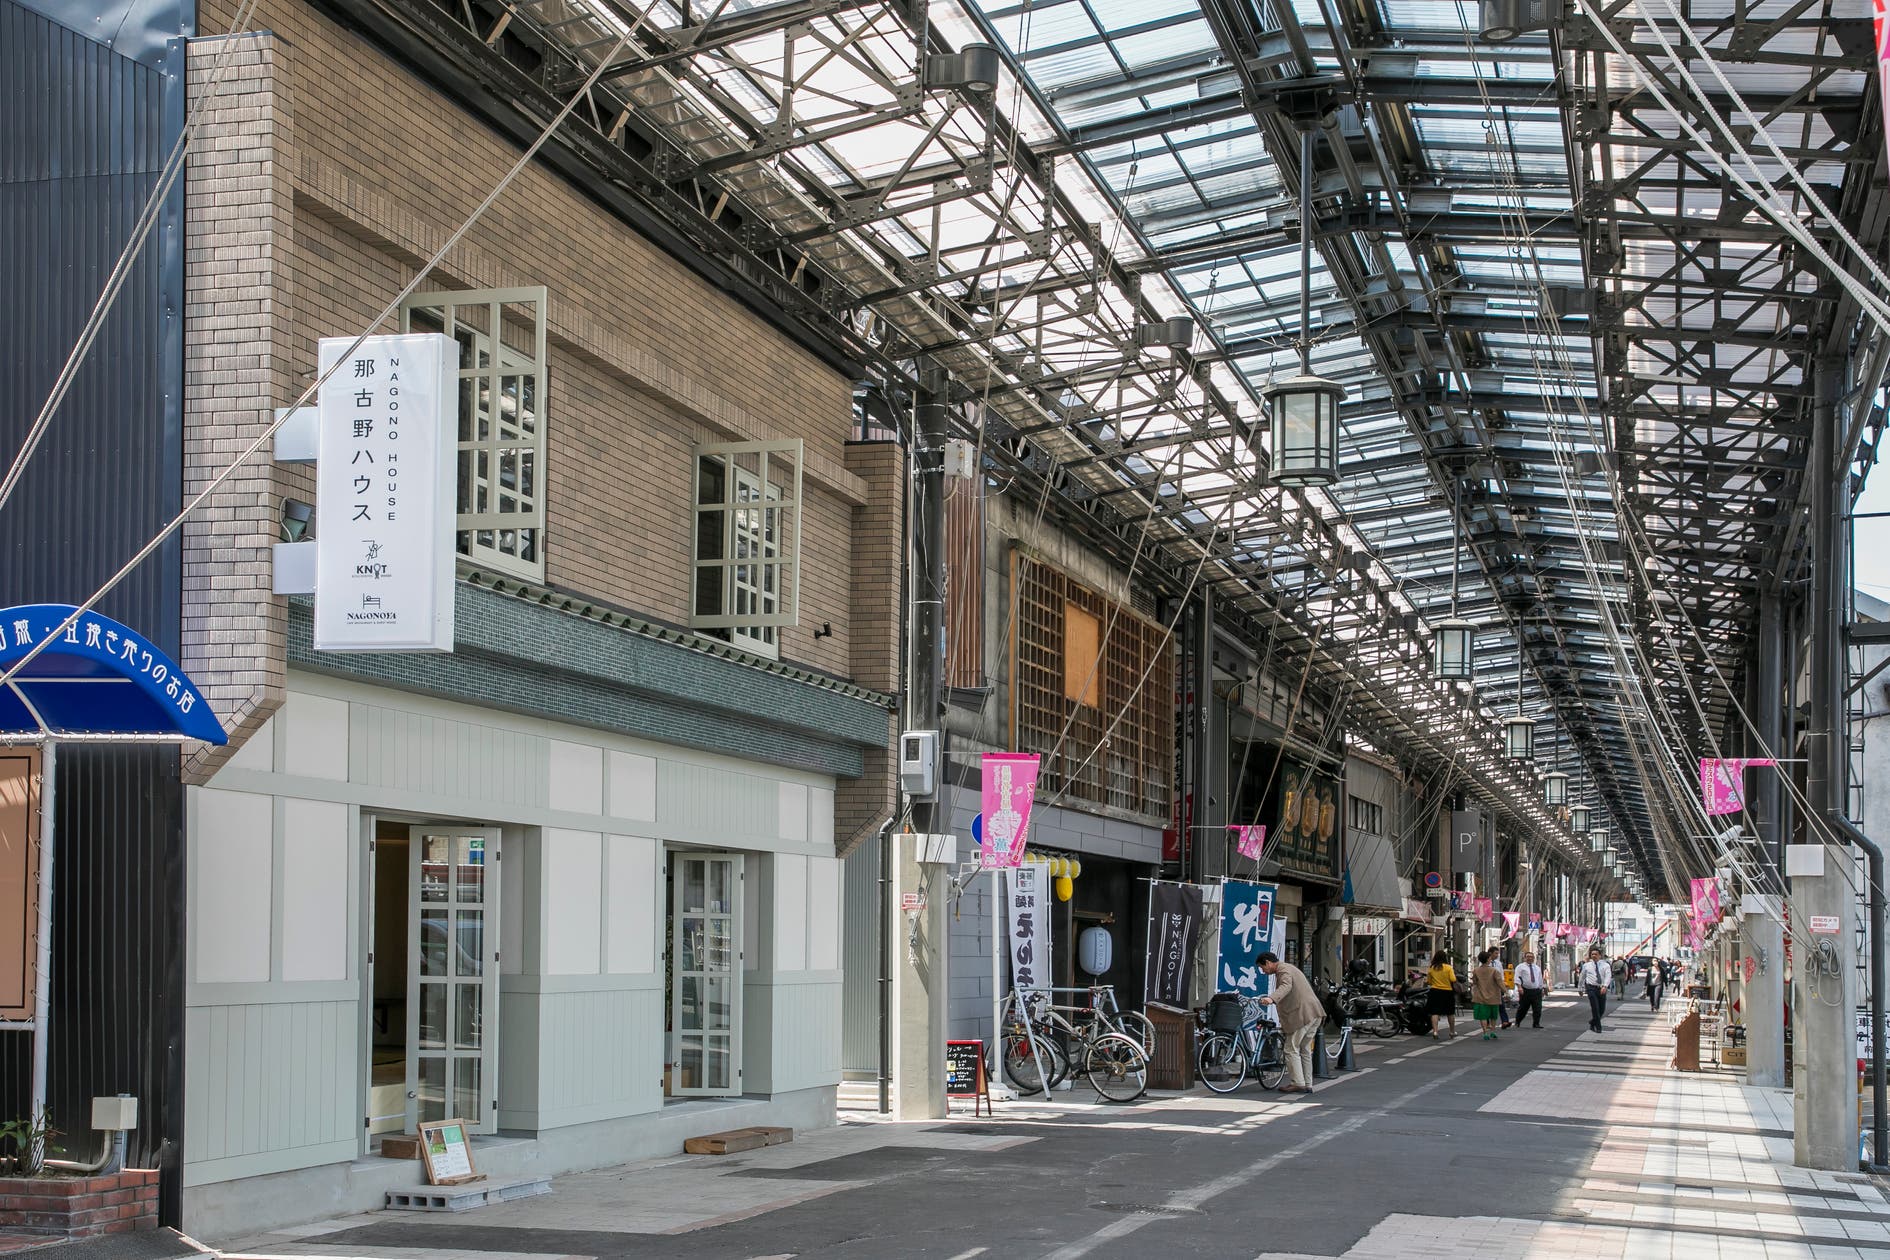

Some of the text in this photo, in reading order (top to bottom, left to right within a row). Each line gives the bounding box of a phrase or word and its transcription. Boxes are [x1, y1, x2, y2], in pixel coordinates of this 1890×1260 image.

[351, 359, 375, 521] 那古野ハウス
[387, 358, 400, 521] NAGONO HOUSE
[347, 612, 397, 620] NAGONOYA
